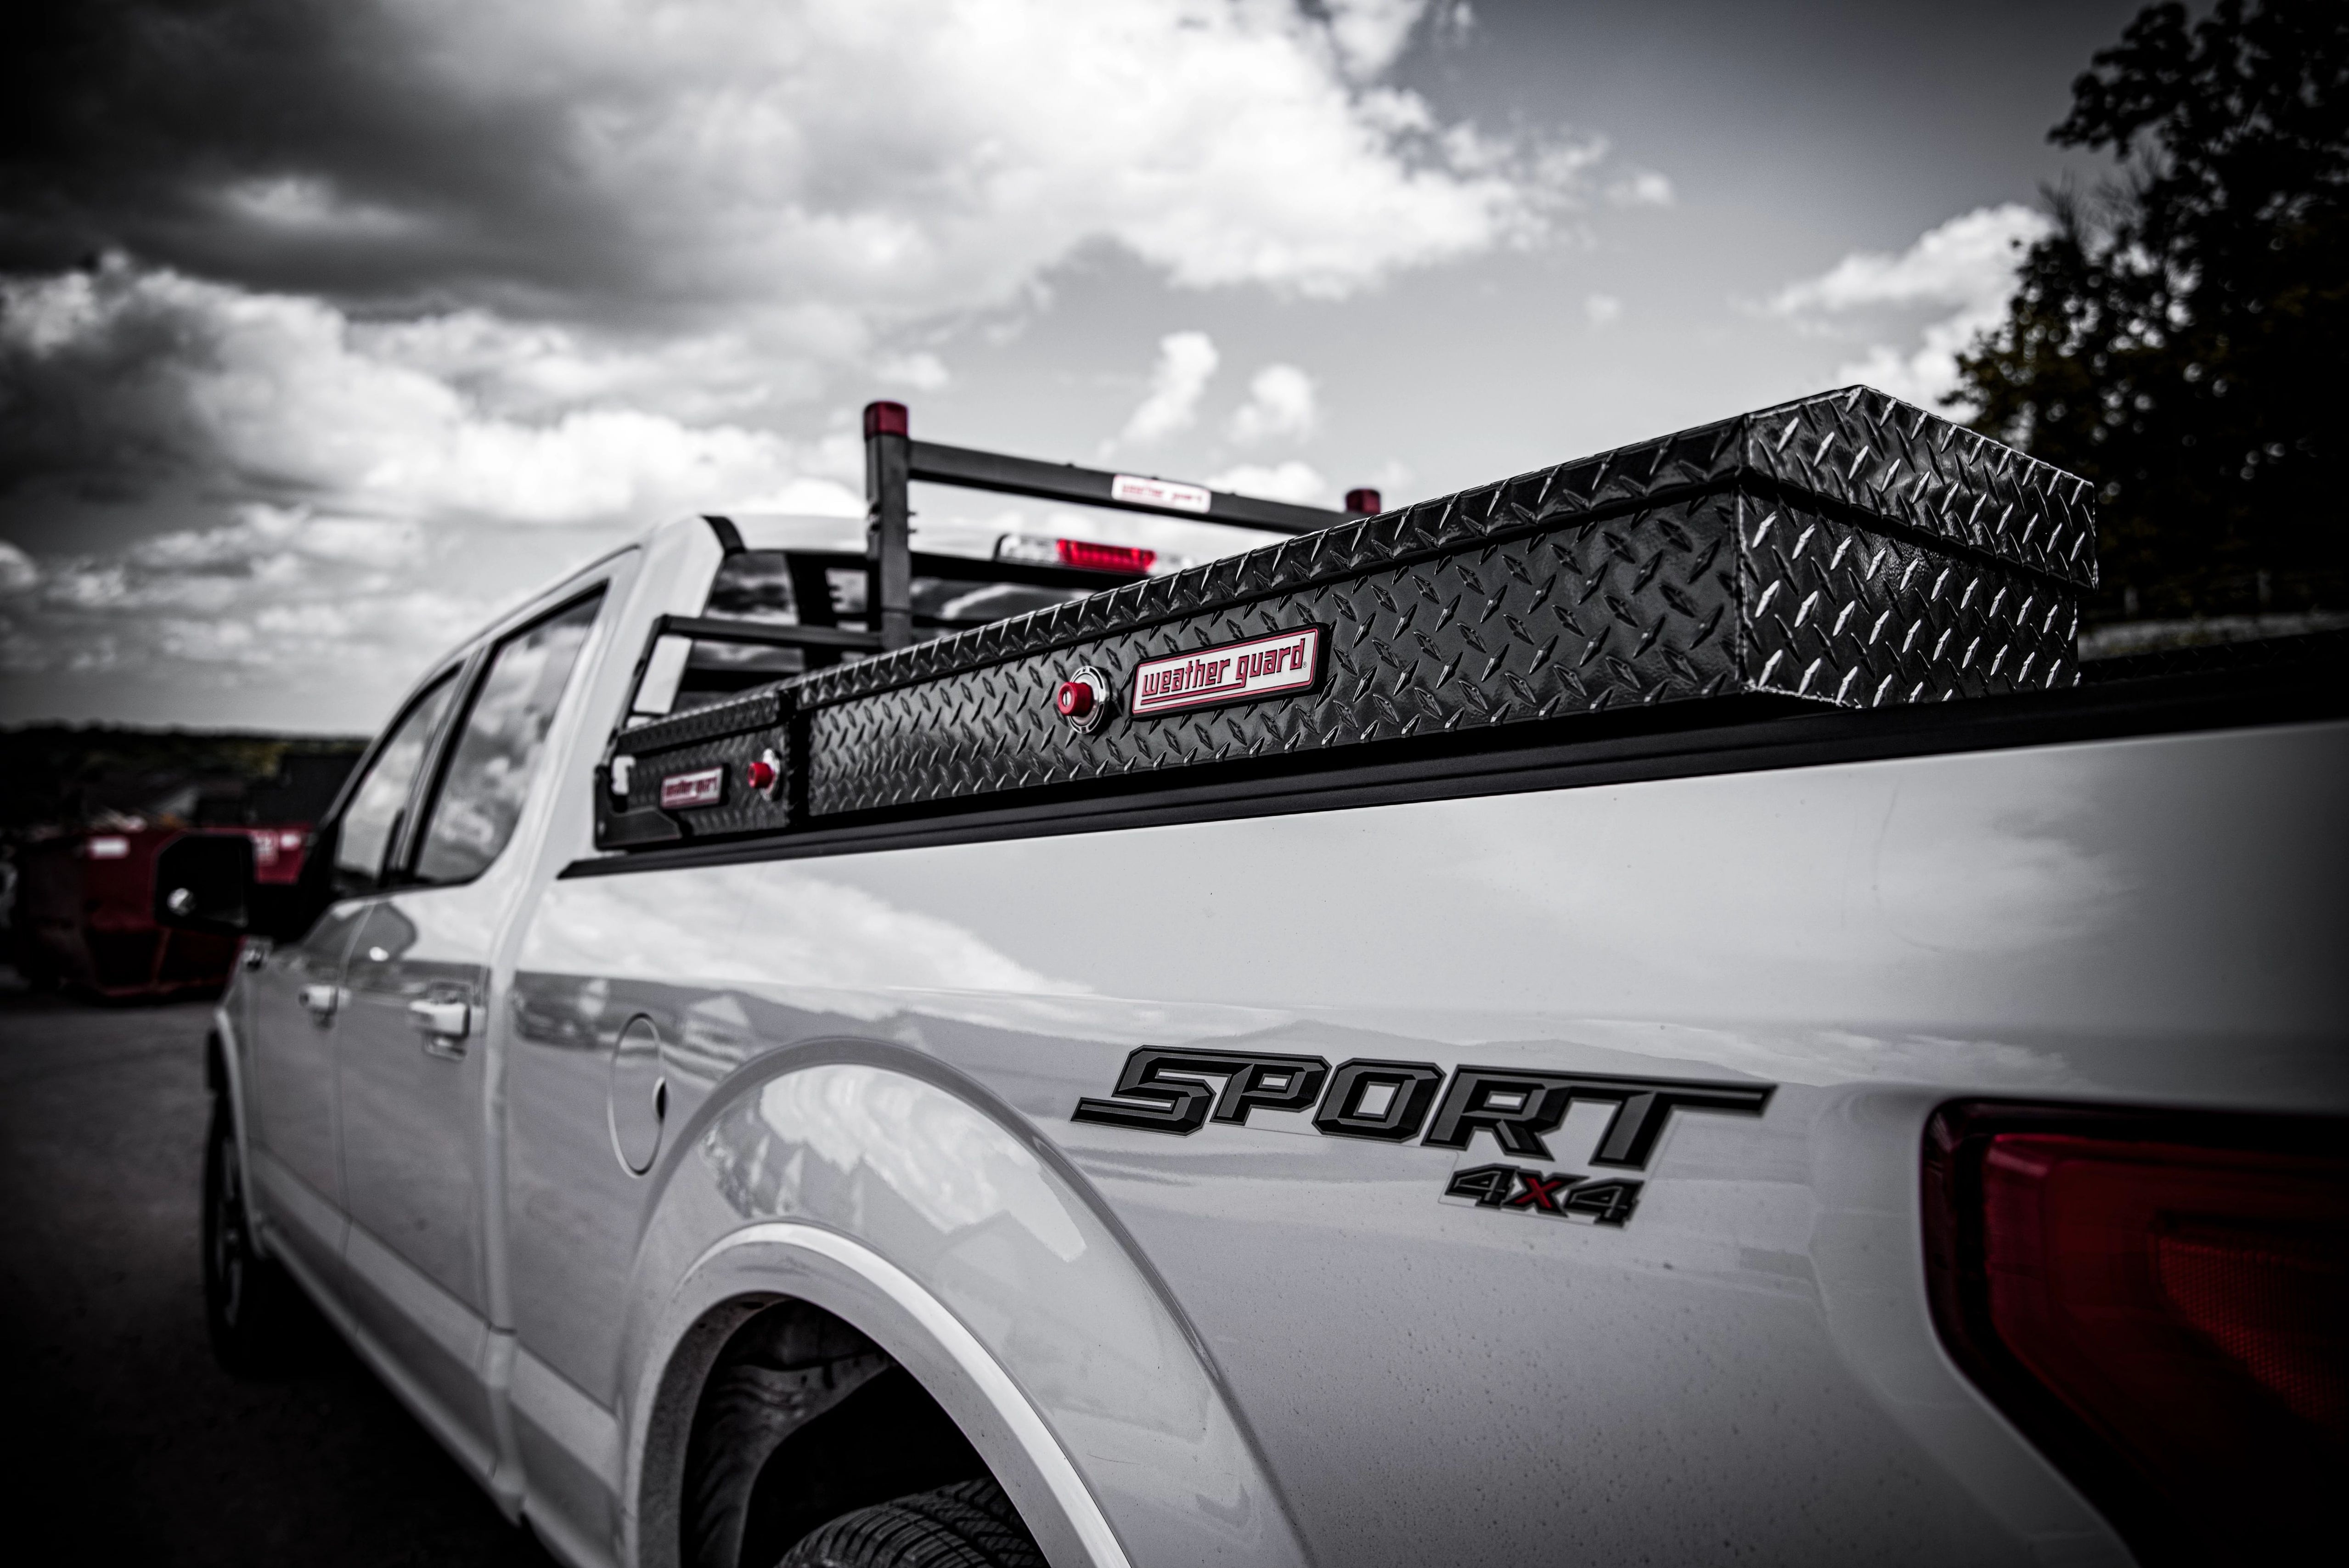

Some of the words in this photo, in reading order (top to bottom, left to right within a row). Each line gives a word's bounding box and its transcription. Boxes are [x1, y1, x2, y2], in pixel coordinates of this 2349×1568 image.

[1142, 659, 1231, 697] weather
[1235, 638, 1306, 688] guard
[1070, 1045, 1778, 1172] SPORT
